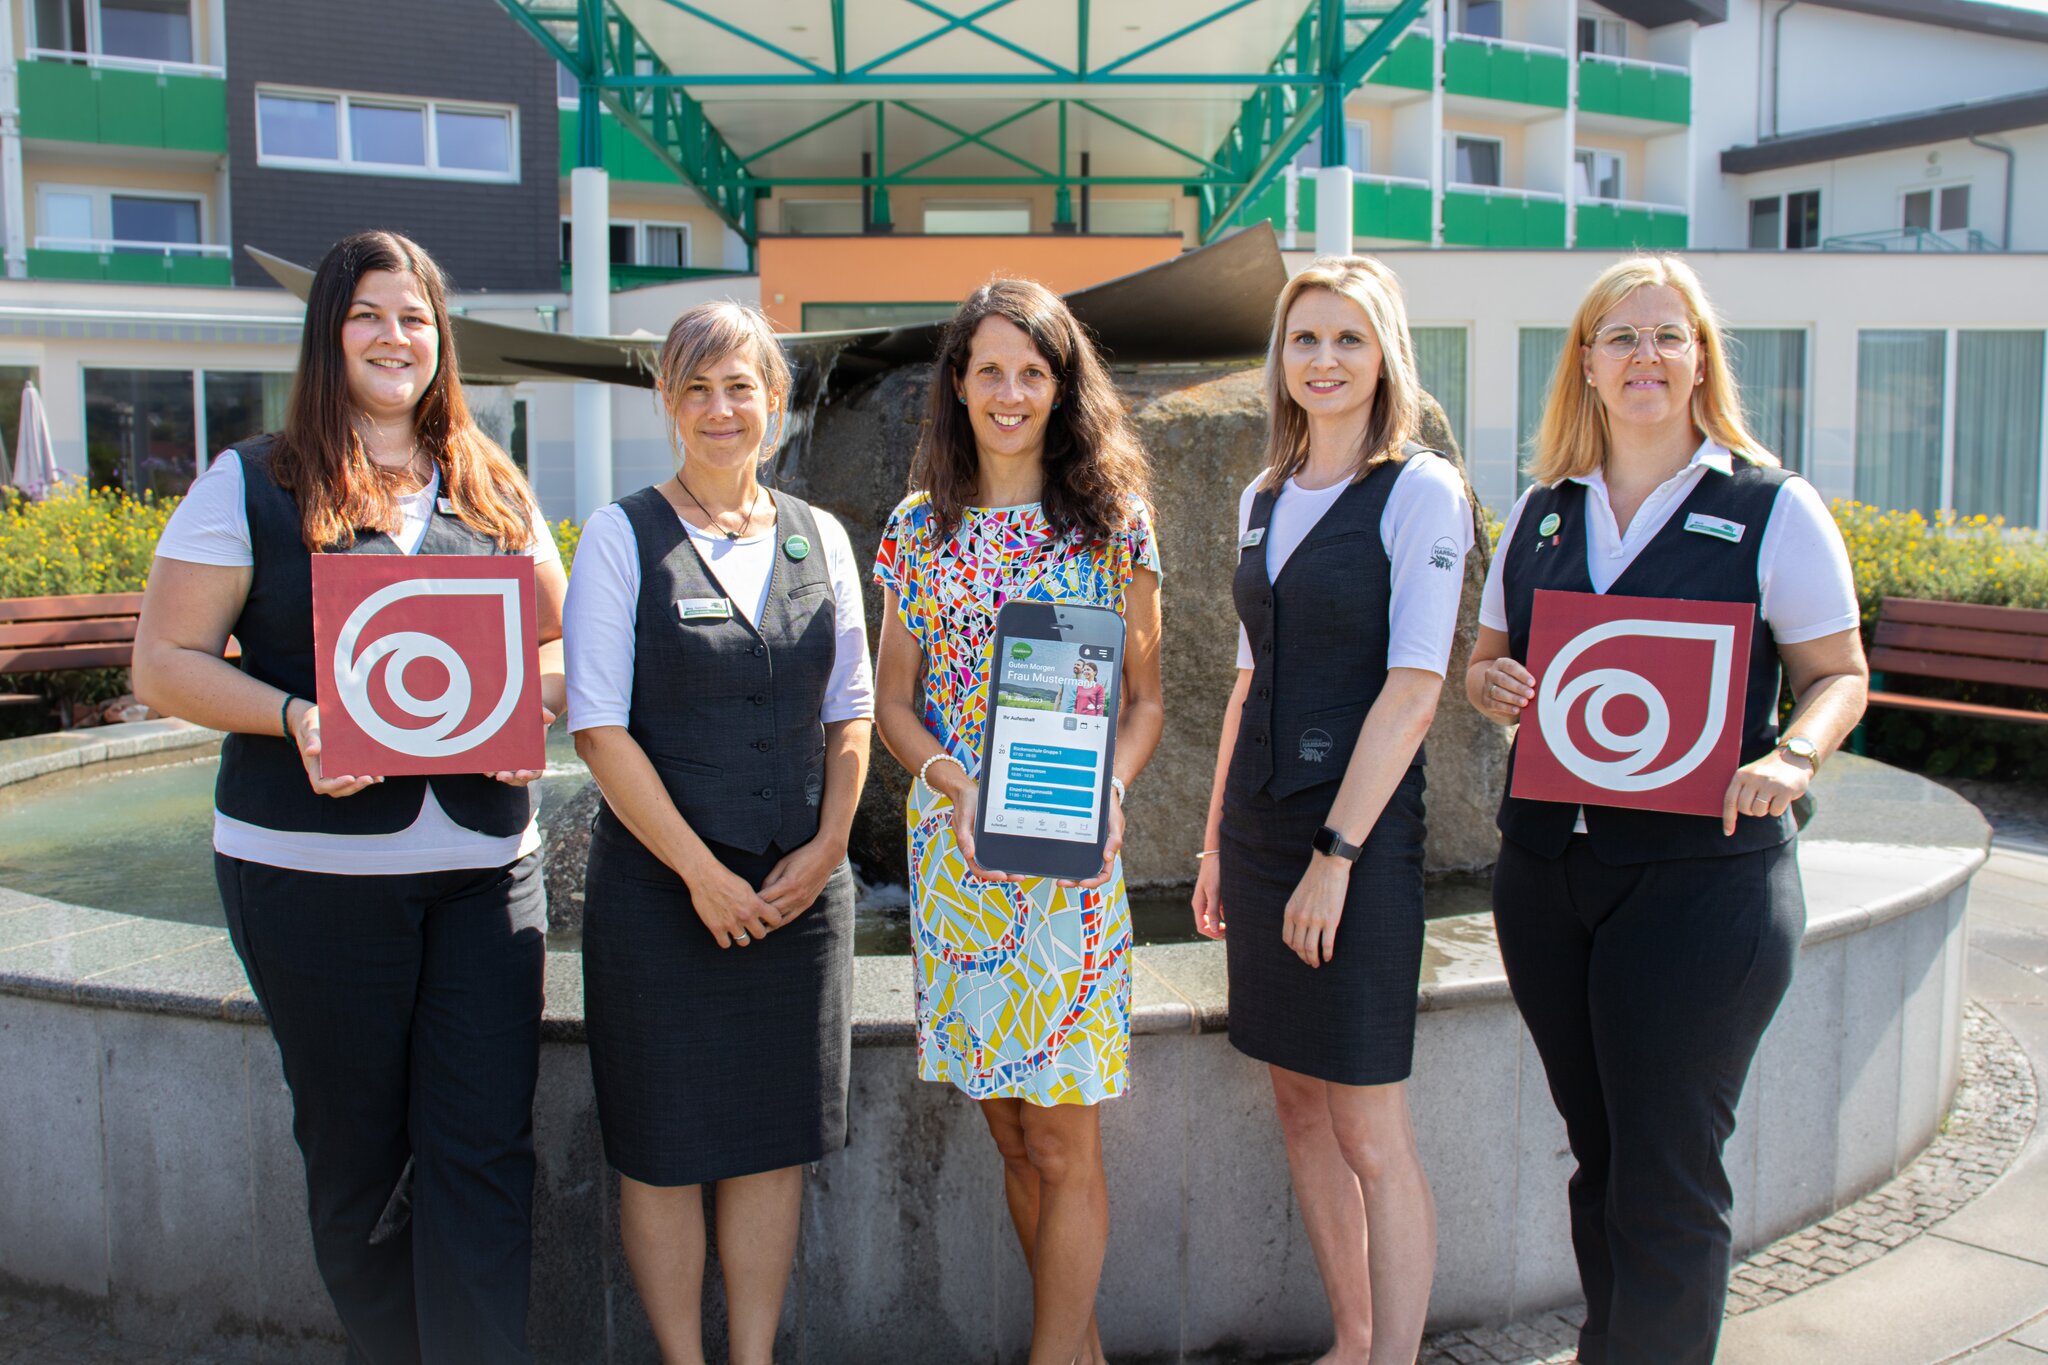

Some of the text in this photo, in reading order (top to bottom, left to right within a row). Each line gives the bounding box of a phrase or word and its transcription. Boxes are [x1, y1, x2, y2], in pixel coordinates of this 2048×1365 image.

[1008, 661, 1056, 673] Guten Morgen
[1007, 670, 1097, 688] Frau Mustermann
